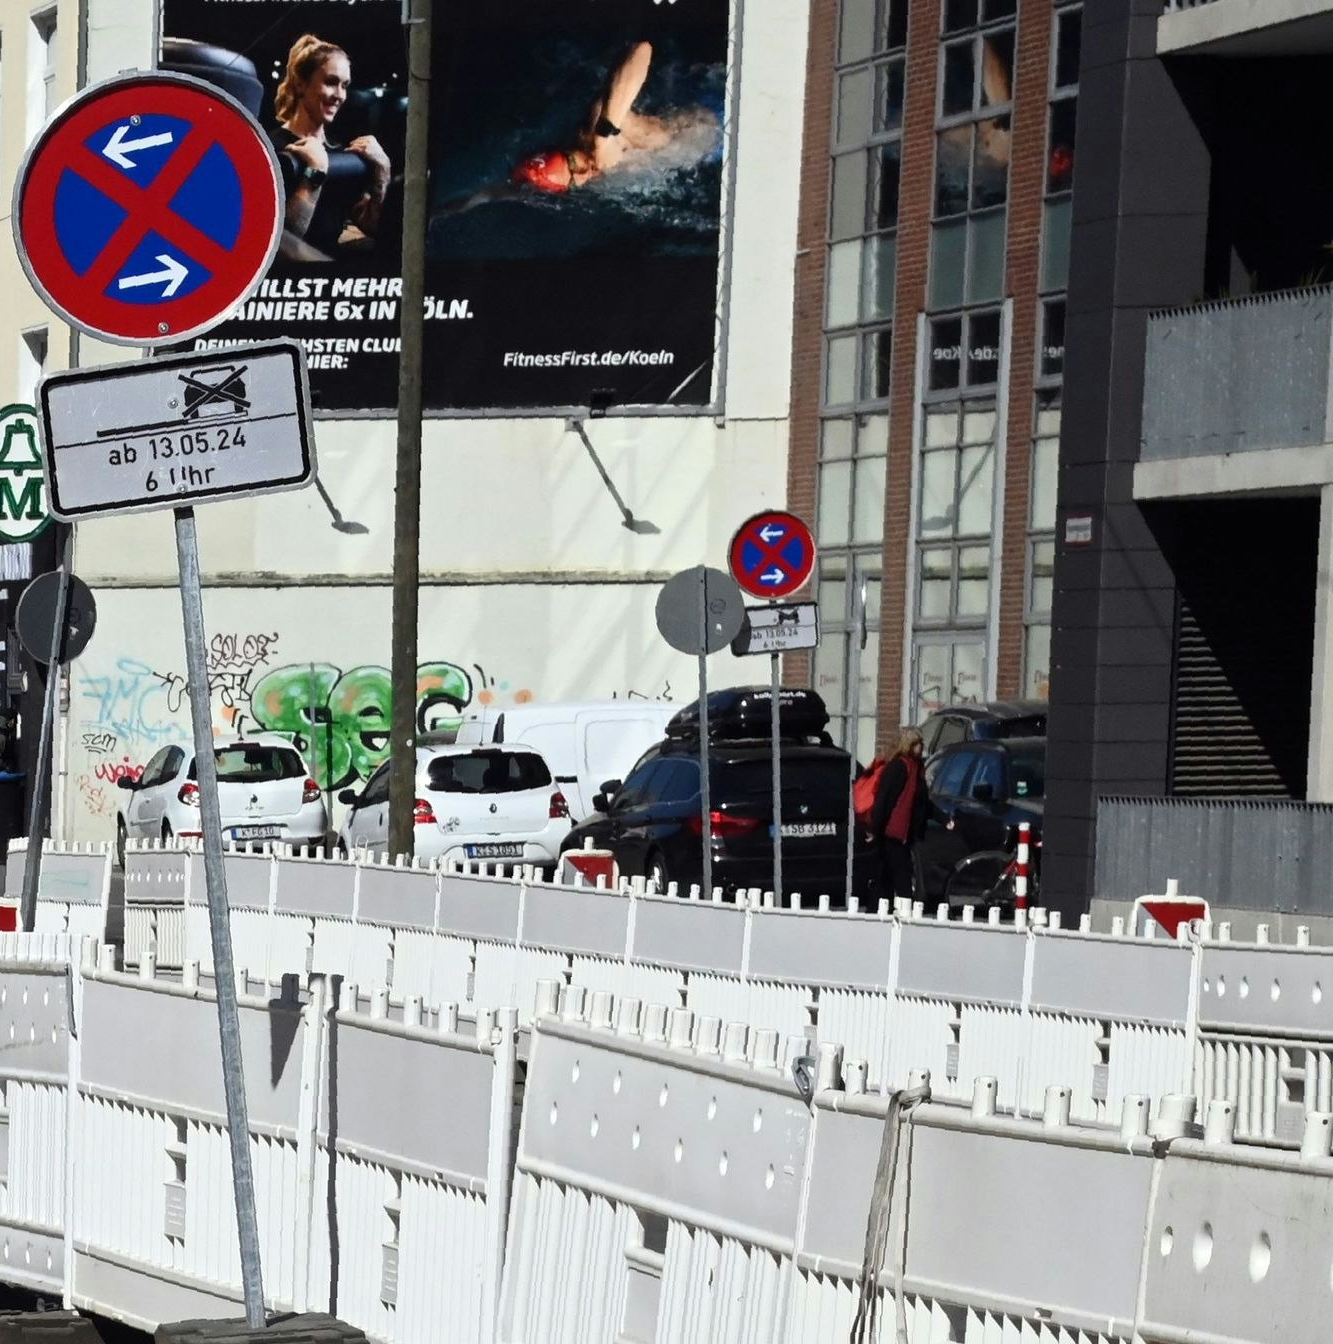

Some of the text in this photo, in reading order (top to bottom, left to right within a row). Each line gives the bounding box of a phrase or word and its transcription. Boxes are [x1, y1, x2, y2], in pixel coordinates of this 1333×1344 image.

[250, 278, 402, 298] ILLST MEHR
[334, 302, 365, 320] 6x
[369, 301, 396, 320] IN
[424, 296, 474, 319] ÖLN.
[503, 349, 675, 367] FitnessFirst.de/Koeln
[109, 427, 247, 466] ab 13.05.24
[145, 465, 216, 491] 6 Uhr
[753, 627, 799, 640] ab 13.05.24
